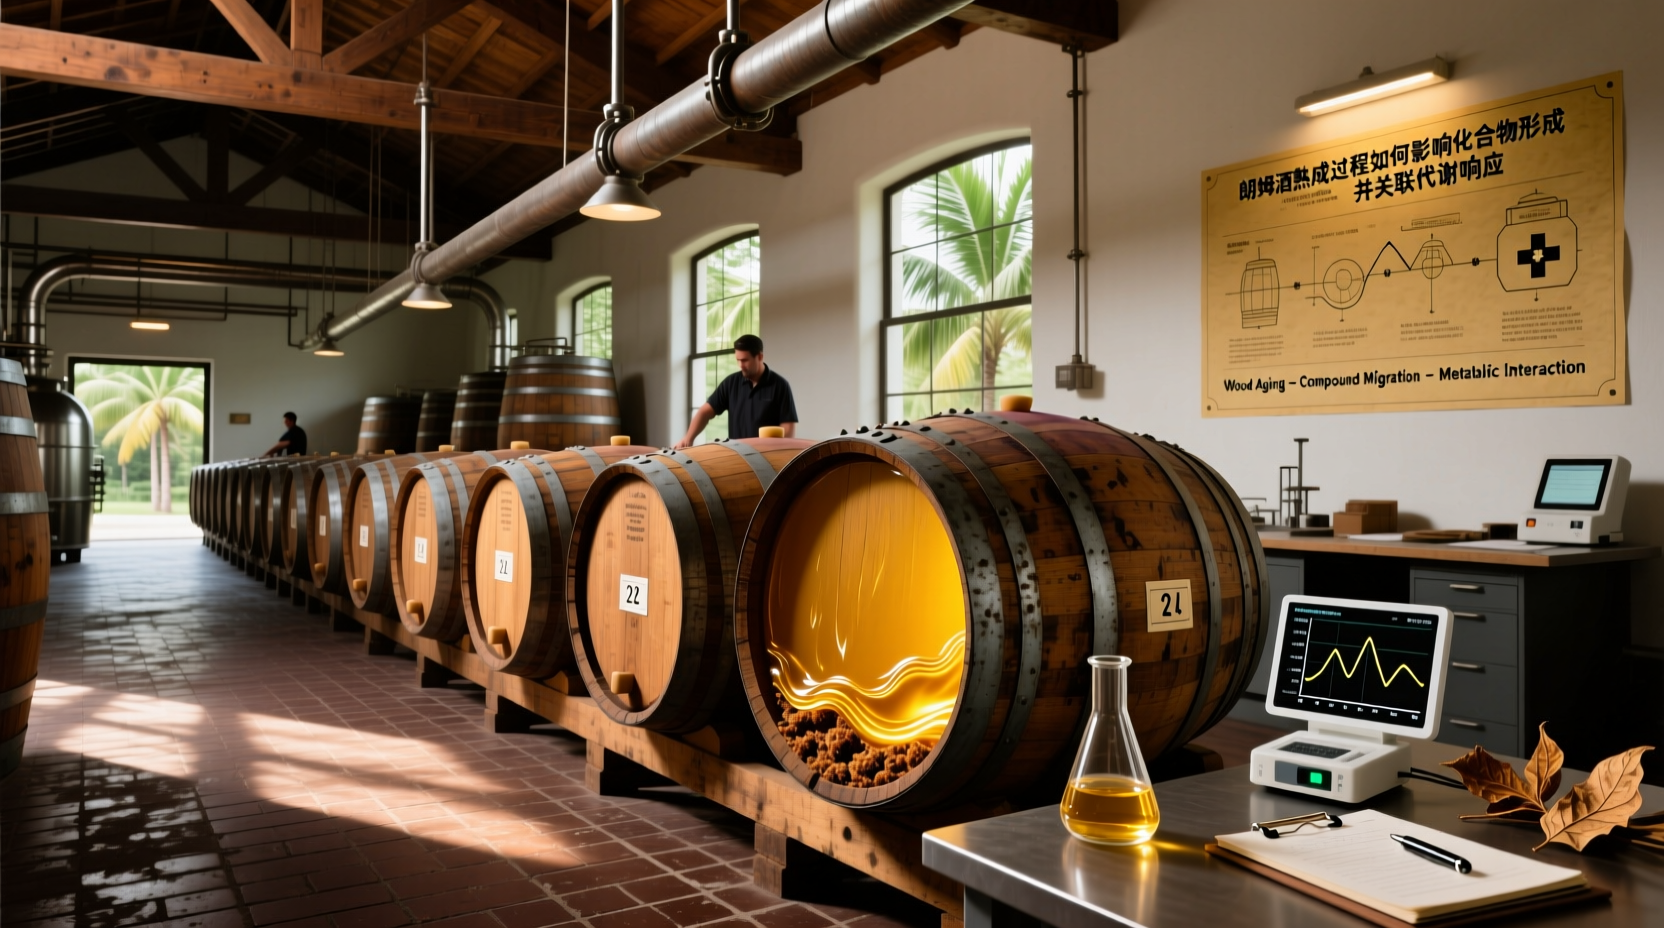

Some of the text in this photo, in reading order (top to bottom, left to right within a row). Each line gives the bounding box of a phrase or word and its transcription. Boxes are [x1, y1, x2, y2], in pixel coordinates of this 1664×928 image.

[1223, 378, 1253, 392] Wood
[1255, 376, 1286, 394] Aging
[1299, 371, 1360, 391] Compound
[1363, 369, 1421, 389] Migration
[1504, 359, 1586, 378] Interaction
[626, 584, 640, 605] 22
